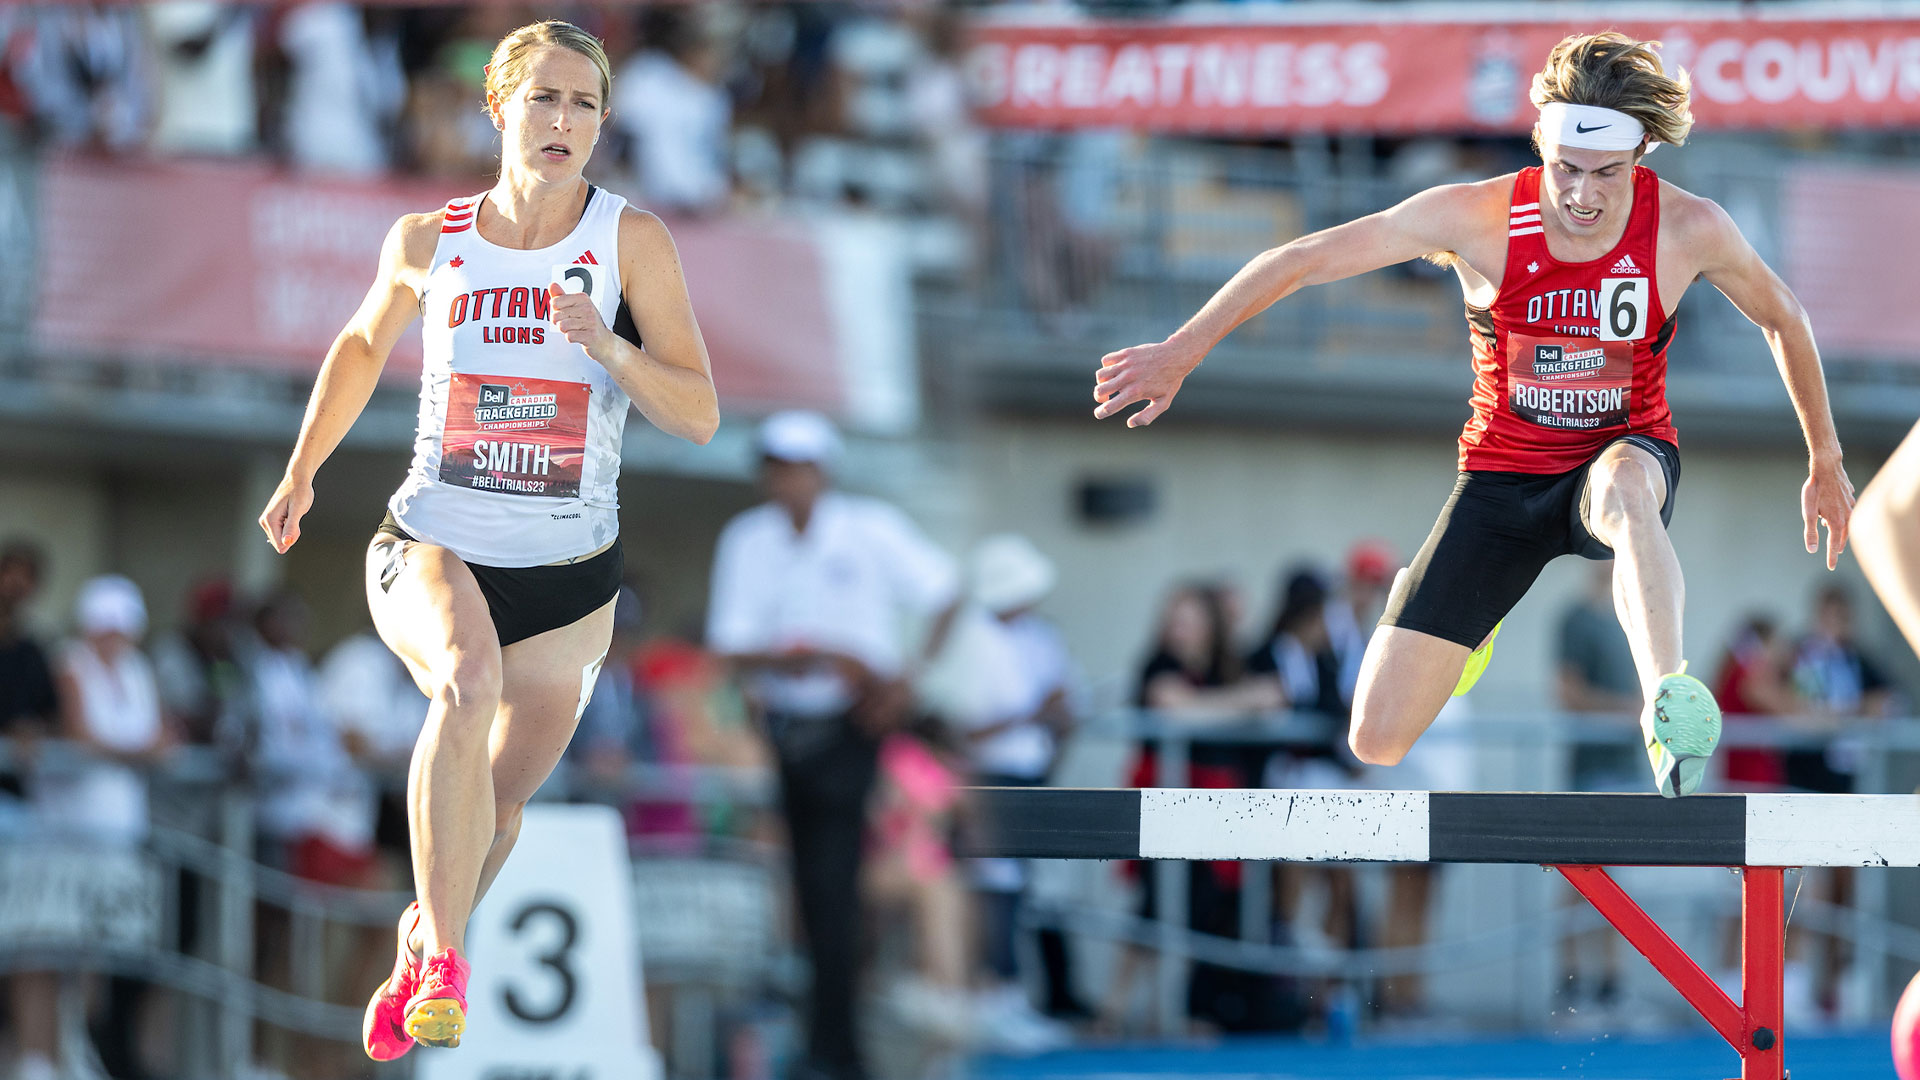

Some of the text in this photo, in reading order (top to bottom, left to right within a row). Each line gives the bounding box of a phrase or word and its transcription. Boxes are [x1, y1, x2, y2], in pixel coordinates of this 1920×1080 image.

[1611, 266, 1641, 274] adidas
[448, 287, 550, 329] OTTAW
[1609, 281, 1637, 338] 6
[483, 327, 545, 344] LIONS
[1540, 349, 1558, 360] Bell
[1564, 350, 1602, 361] CANADIAN
[1534, 356, 1604, 374] TRACK&FIELD
[1542, 370, 1596, 381] CHAMPIONSHIPS
[484, 390, 504, 403] Bell
[510, 395, 554, 405] CANADIAN
[1515, 383, 1623, 414] ROBERTSON
[475, 404, 557, 421] TRACK&FIELD
[1537, 414, 1600, 428] #BELLTRIALS23
[483, 420, 545, 431] CHAMPIONSHIPS
[472, 439, 551, 476] SMITH
[472, 475, 545, 493] #BELLTRIALS23
[503, 900, 582, 1024] 3
